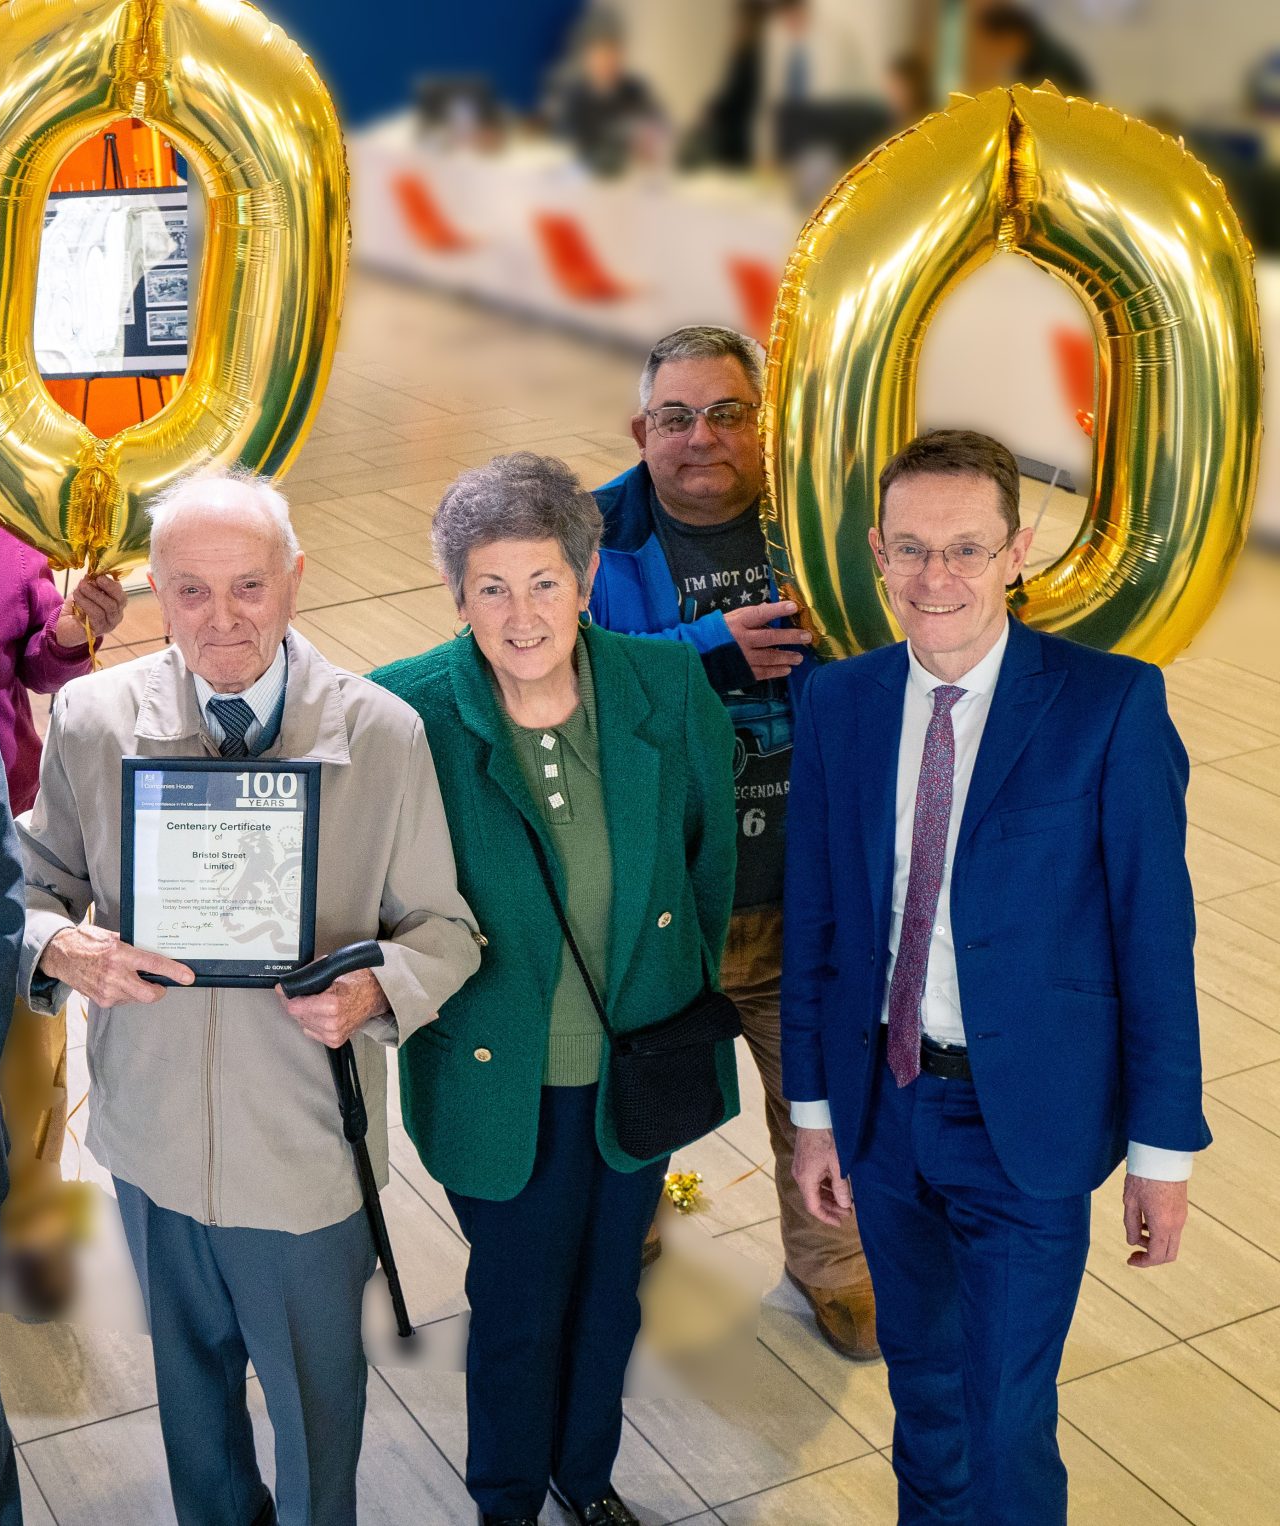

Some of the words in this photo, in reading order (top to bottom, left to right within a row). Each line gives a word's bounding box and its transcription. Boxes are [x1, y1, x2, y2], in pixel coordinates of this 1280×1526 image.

[683, 575, 707, 593] I'M
[710, 570, 740, 587] NOT
[236, 772, 298, 798] 100
[734, 781, 790, 799] EGENDAR
[248, 799, 285, 807] YEARS
[166, 822, 217, 832] Centenary
[220, 822, 272, 831] Certificate
[736, 808, 766, 837] 6
